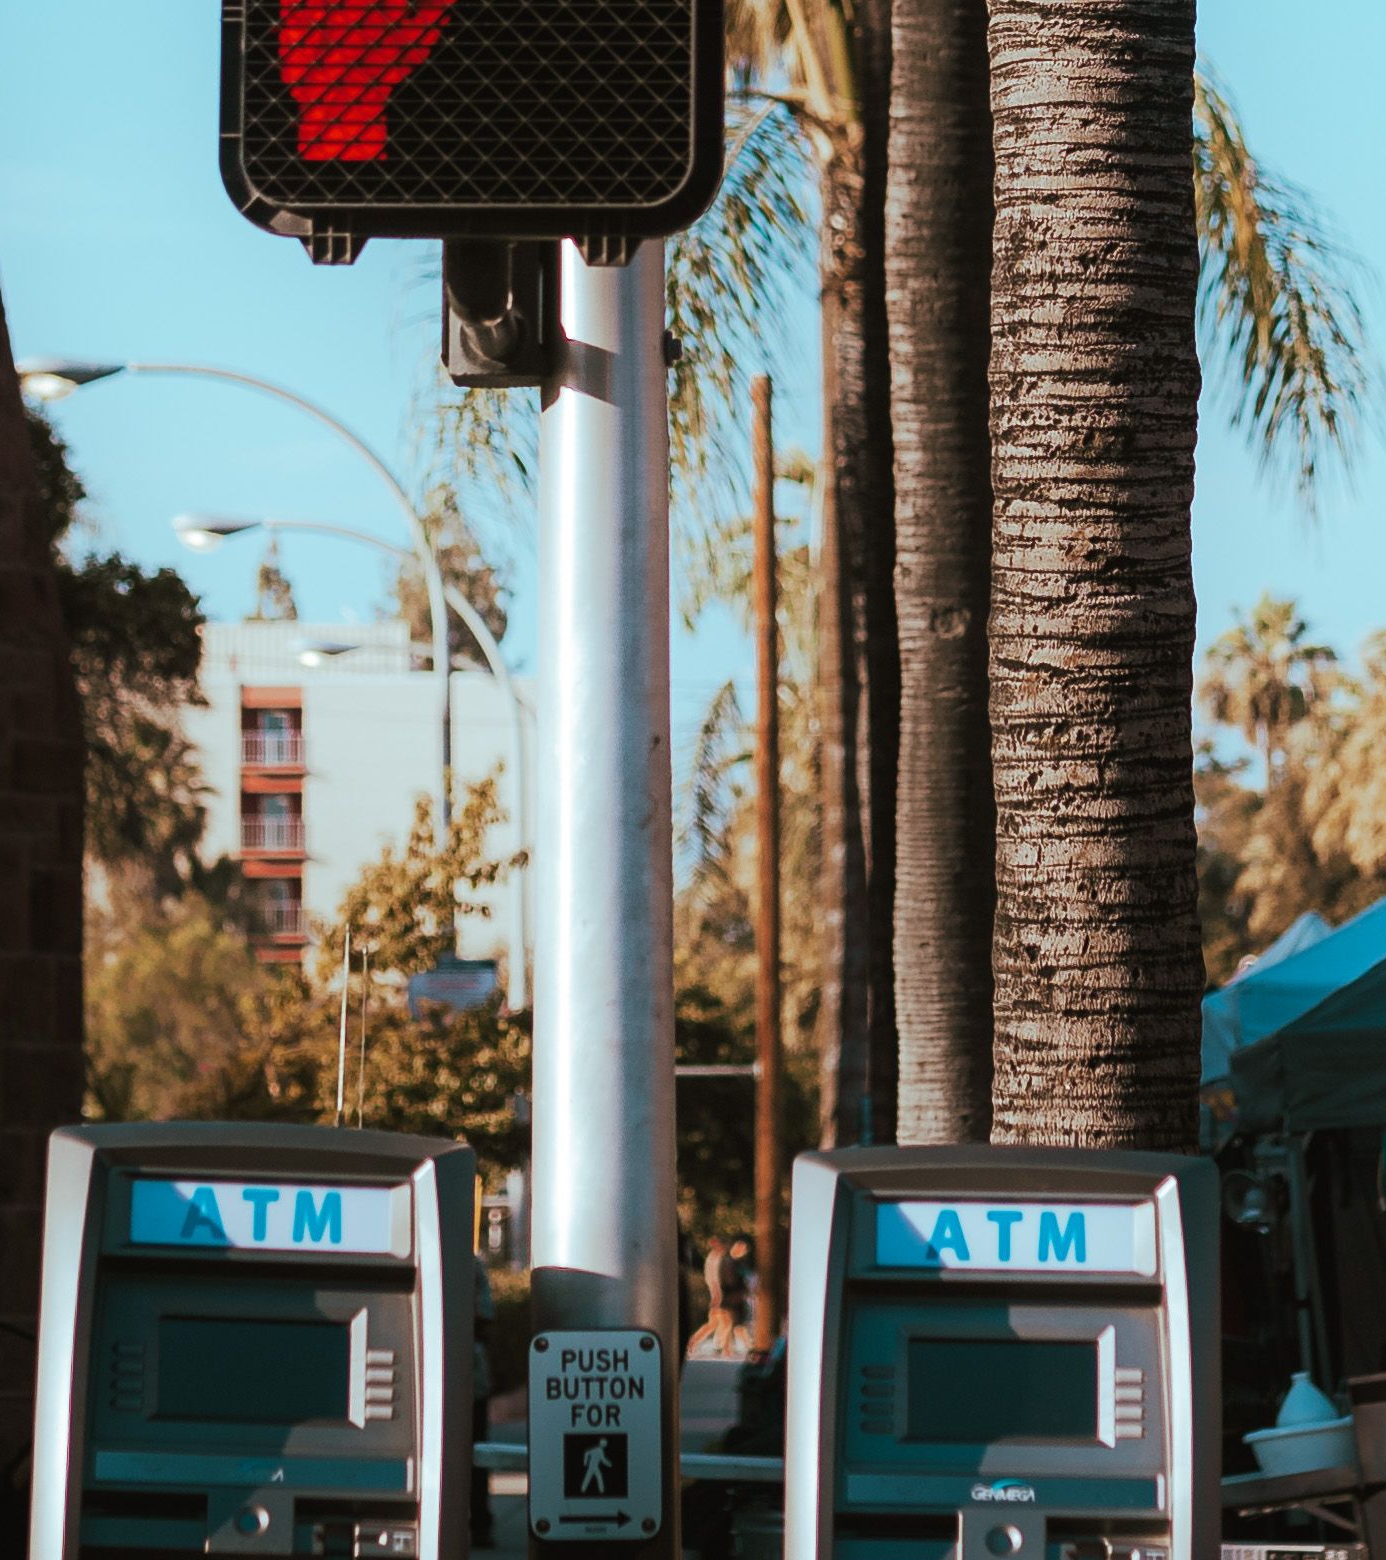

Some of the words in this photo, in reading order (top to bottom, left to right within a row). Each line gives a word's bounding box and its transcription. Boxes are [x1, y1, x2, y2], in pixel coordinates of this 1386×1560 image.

[180, 1186, 342, 1244] ATM
[925, 1209, 1087, 1263] ATM
[561, 1348, 629, 1373] PUSH
[546, 1376, 645, 1400] BUTTON
[570, 1403, 622, 1427] FOR
[971, 1488, 1036, 1502] GENMEGA
